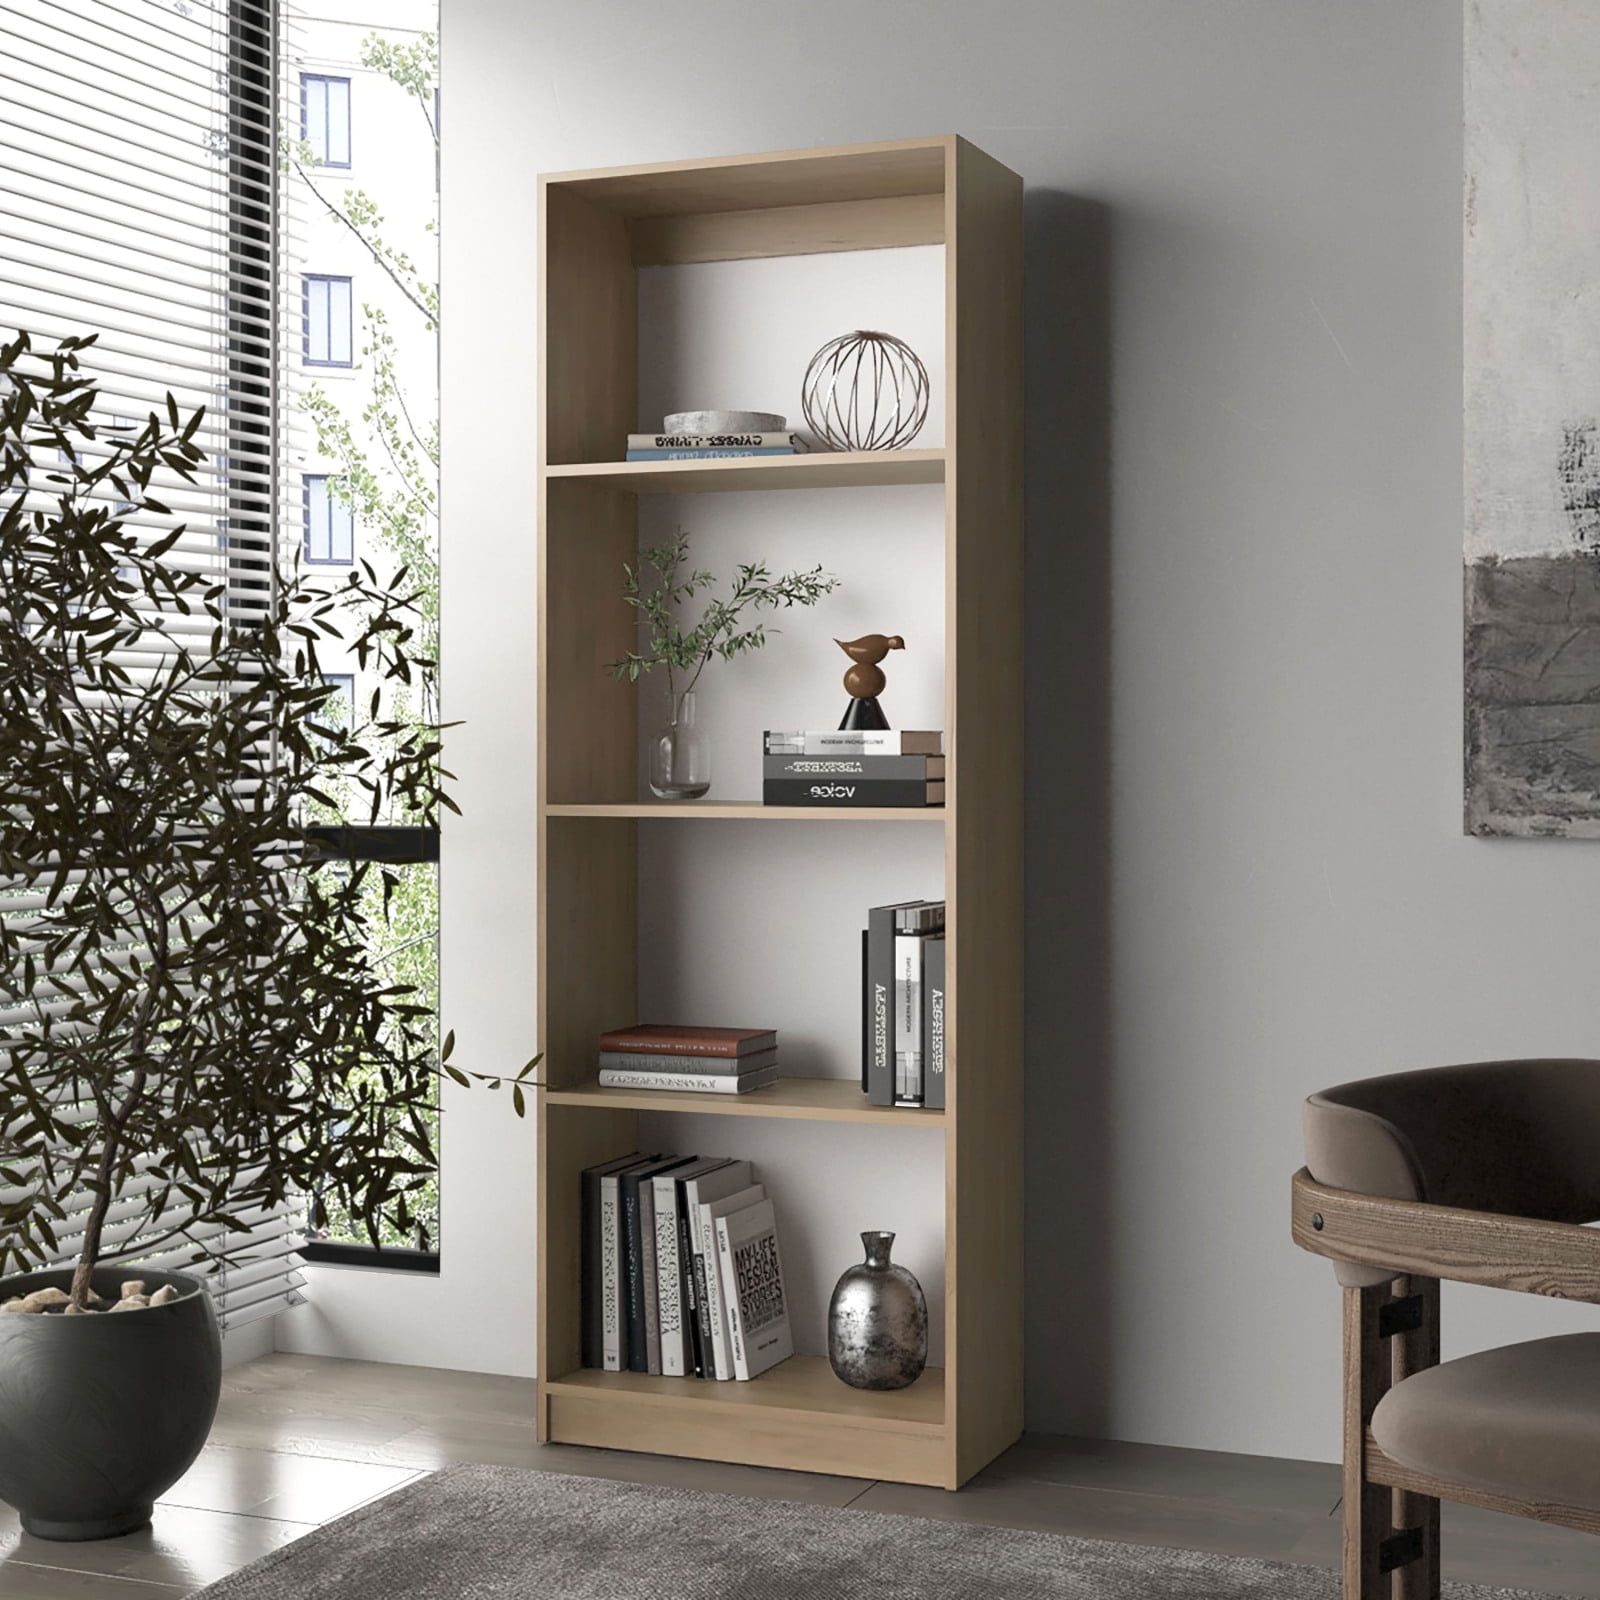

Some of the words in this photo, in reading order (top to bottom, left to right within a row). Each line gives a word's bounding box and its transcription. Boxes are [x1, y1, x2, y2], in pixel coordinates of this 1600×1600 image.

[695, 1256, 706, 1296] Graphic
[737, 1256, 779, 1294] DESIGN
[740, 1277, 782, 1316] STORIES
[699, 1299, 711, 1336] Design
